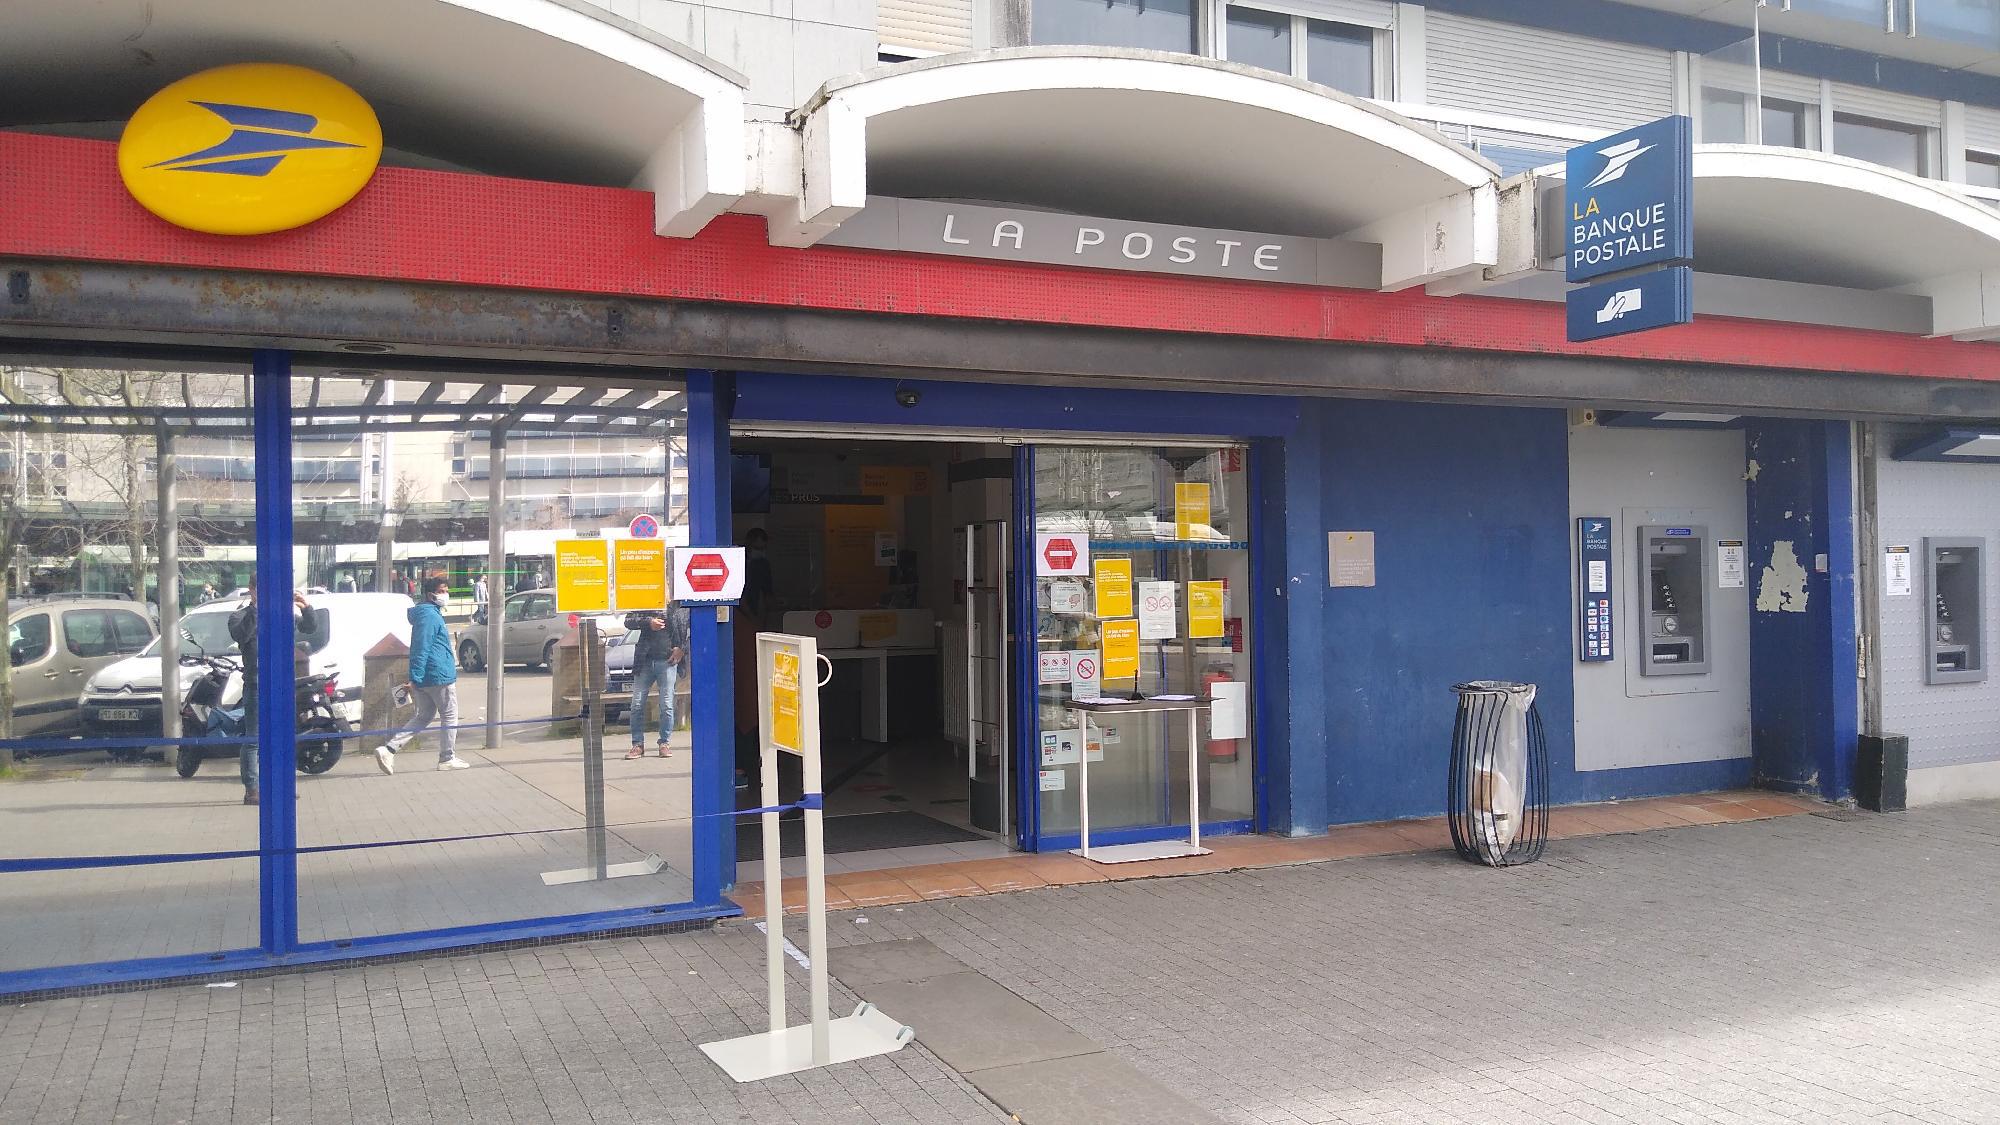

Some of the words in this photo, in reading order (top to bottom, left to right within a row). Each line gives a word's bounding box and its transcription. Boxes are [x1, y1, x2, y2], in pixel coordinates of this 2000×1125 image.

[1574, 197, 1600, 220] LA
[1574, 203, 1665, 244] BANQUE
[942, 214, 1025, 250] LA
[1074, 227, 1283, 272] POSTE
[1574, 229, 1665, 268] POSTALE
